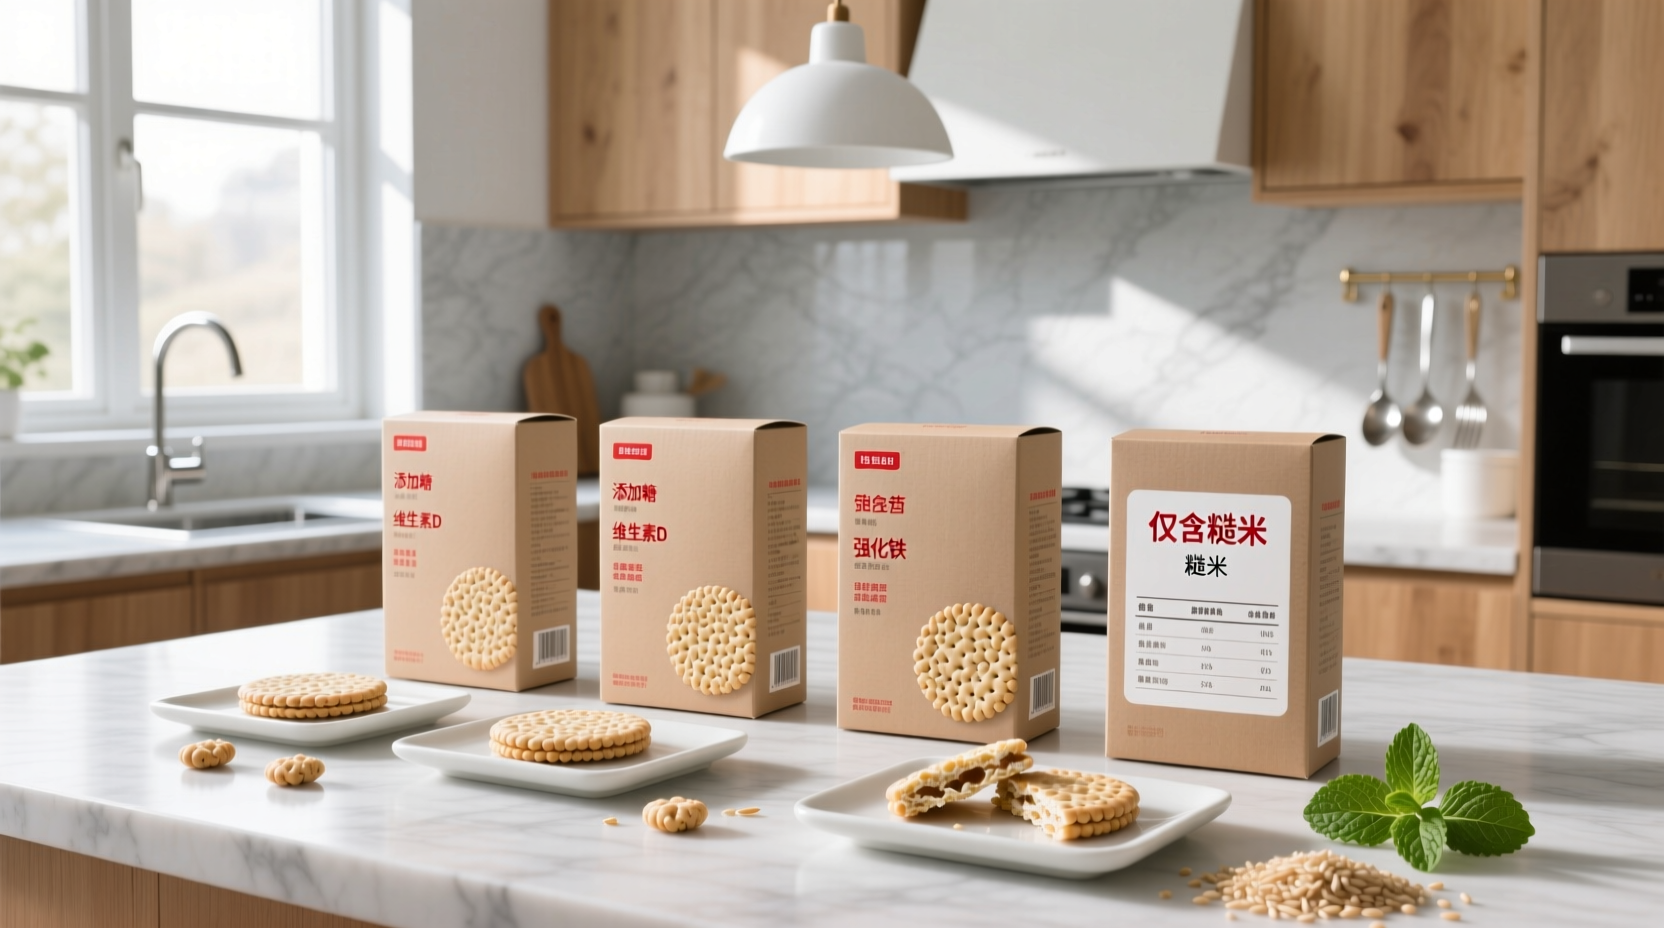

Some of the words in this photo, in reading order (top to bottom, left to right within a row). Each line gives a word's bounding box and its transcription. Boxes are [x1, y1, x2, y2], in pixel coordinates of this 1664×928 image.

[612, 482, 657, 503] 添加糖
[612, 521, 667, 542] 维生素D
[1148, 510, 1267, 547] 仅含糙米
[1184, 554, 1227, 578] 糙米
